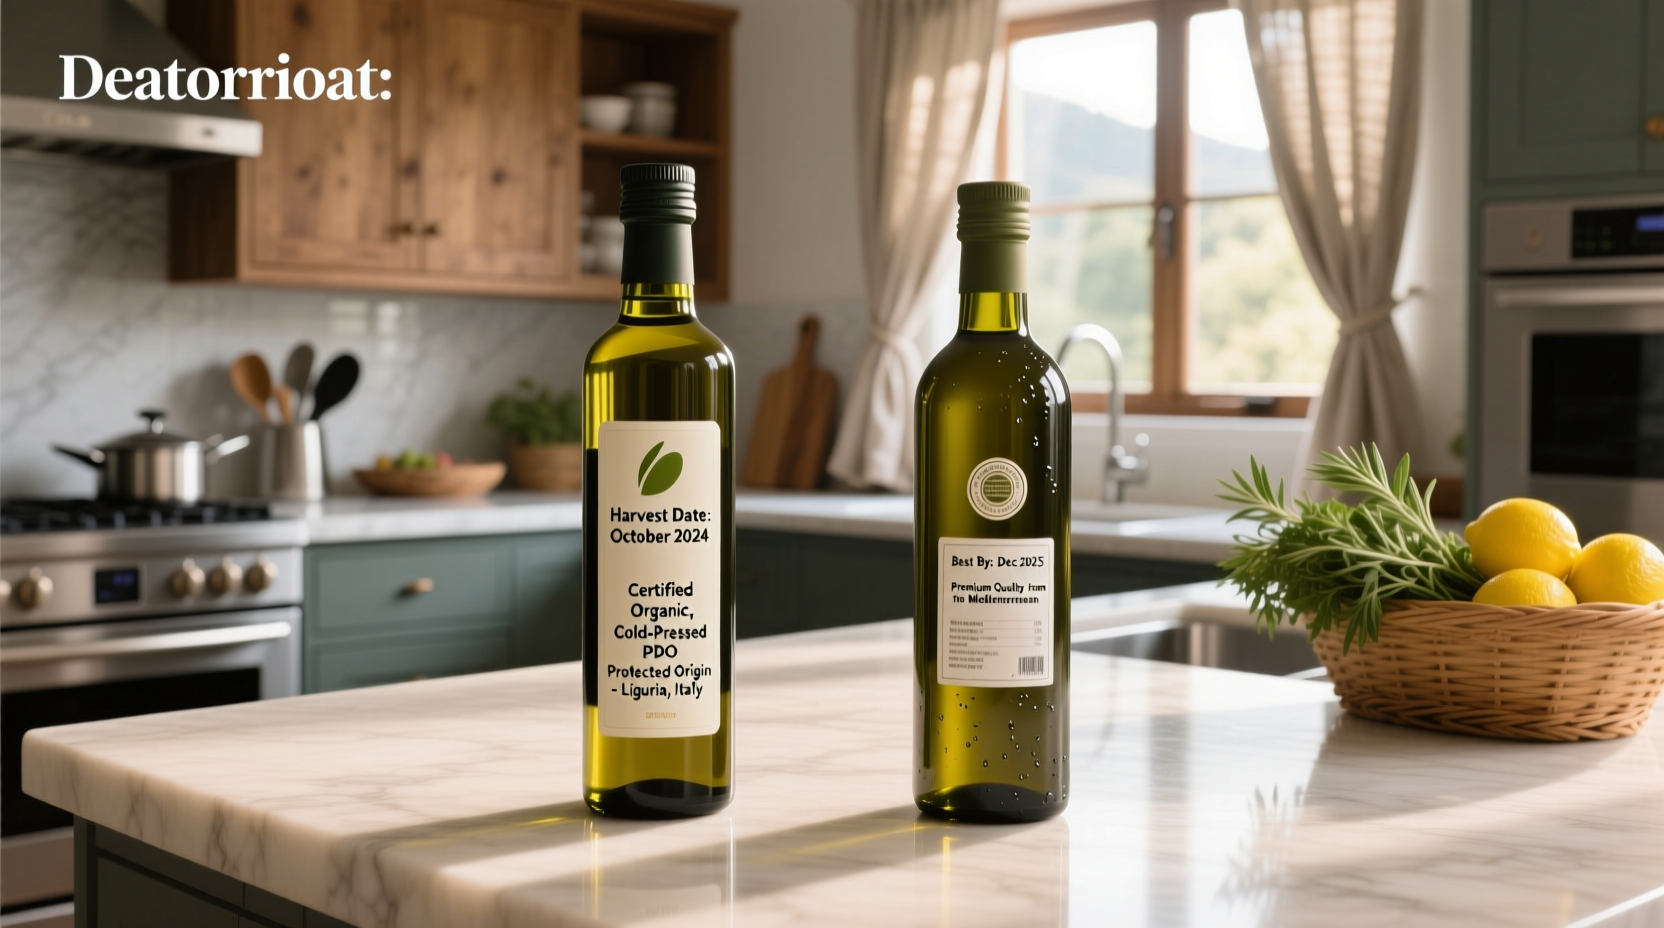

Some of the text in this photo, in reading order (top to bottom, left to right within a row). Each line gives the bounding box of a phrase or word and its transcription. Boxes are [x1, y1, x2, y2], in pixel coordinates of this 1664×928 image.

[610, 507, 711, 522] Harvest Date:
[610, 528, 709, 543] October 2024
[951, 555, 1044, 570] Best By: Dec 2025
[628, 581, 693, 597] Certified
[951, 582, 991, 592] Premium
[631, 602, 694, 622] Organic,
[614, 624, 706, 639] Cold-Pressed
[643, 644, 678, 659] PDO
[607, 663, 711, 681] Protected Origin
[621, 682, 671, 701] Liguria,
[675, 681, 703, 700] Italy
